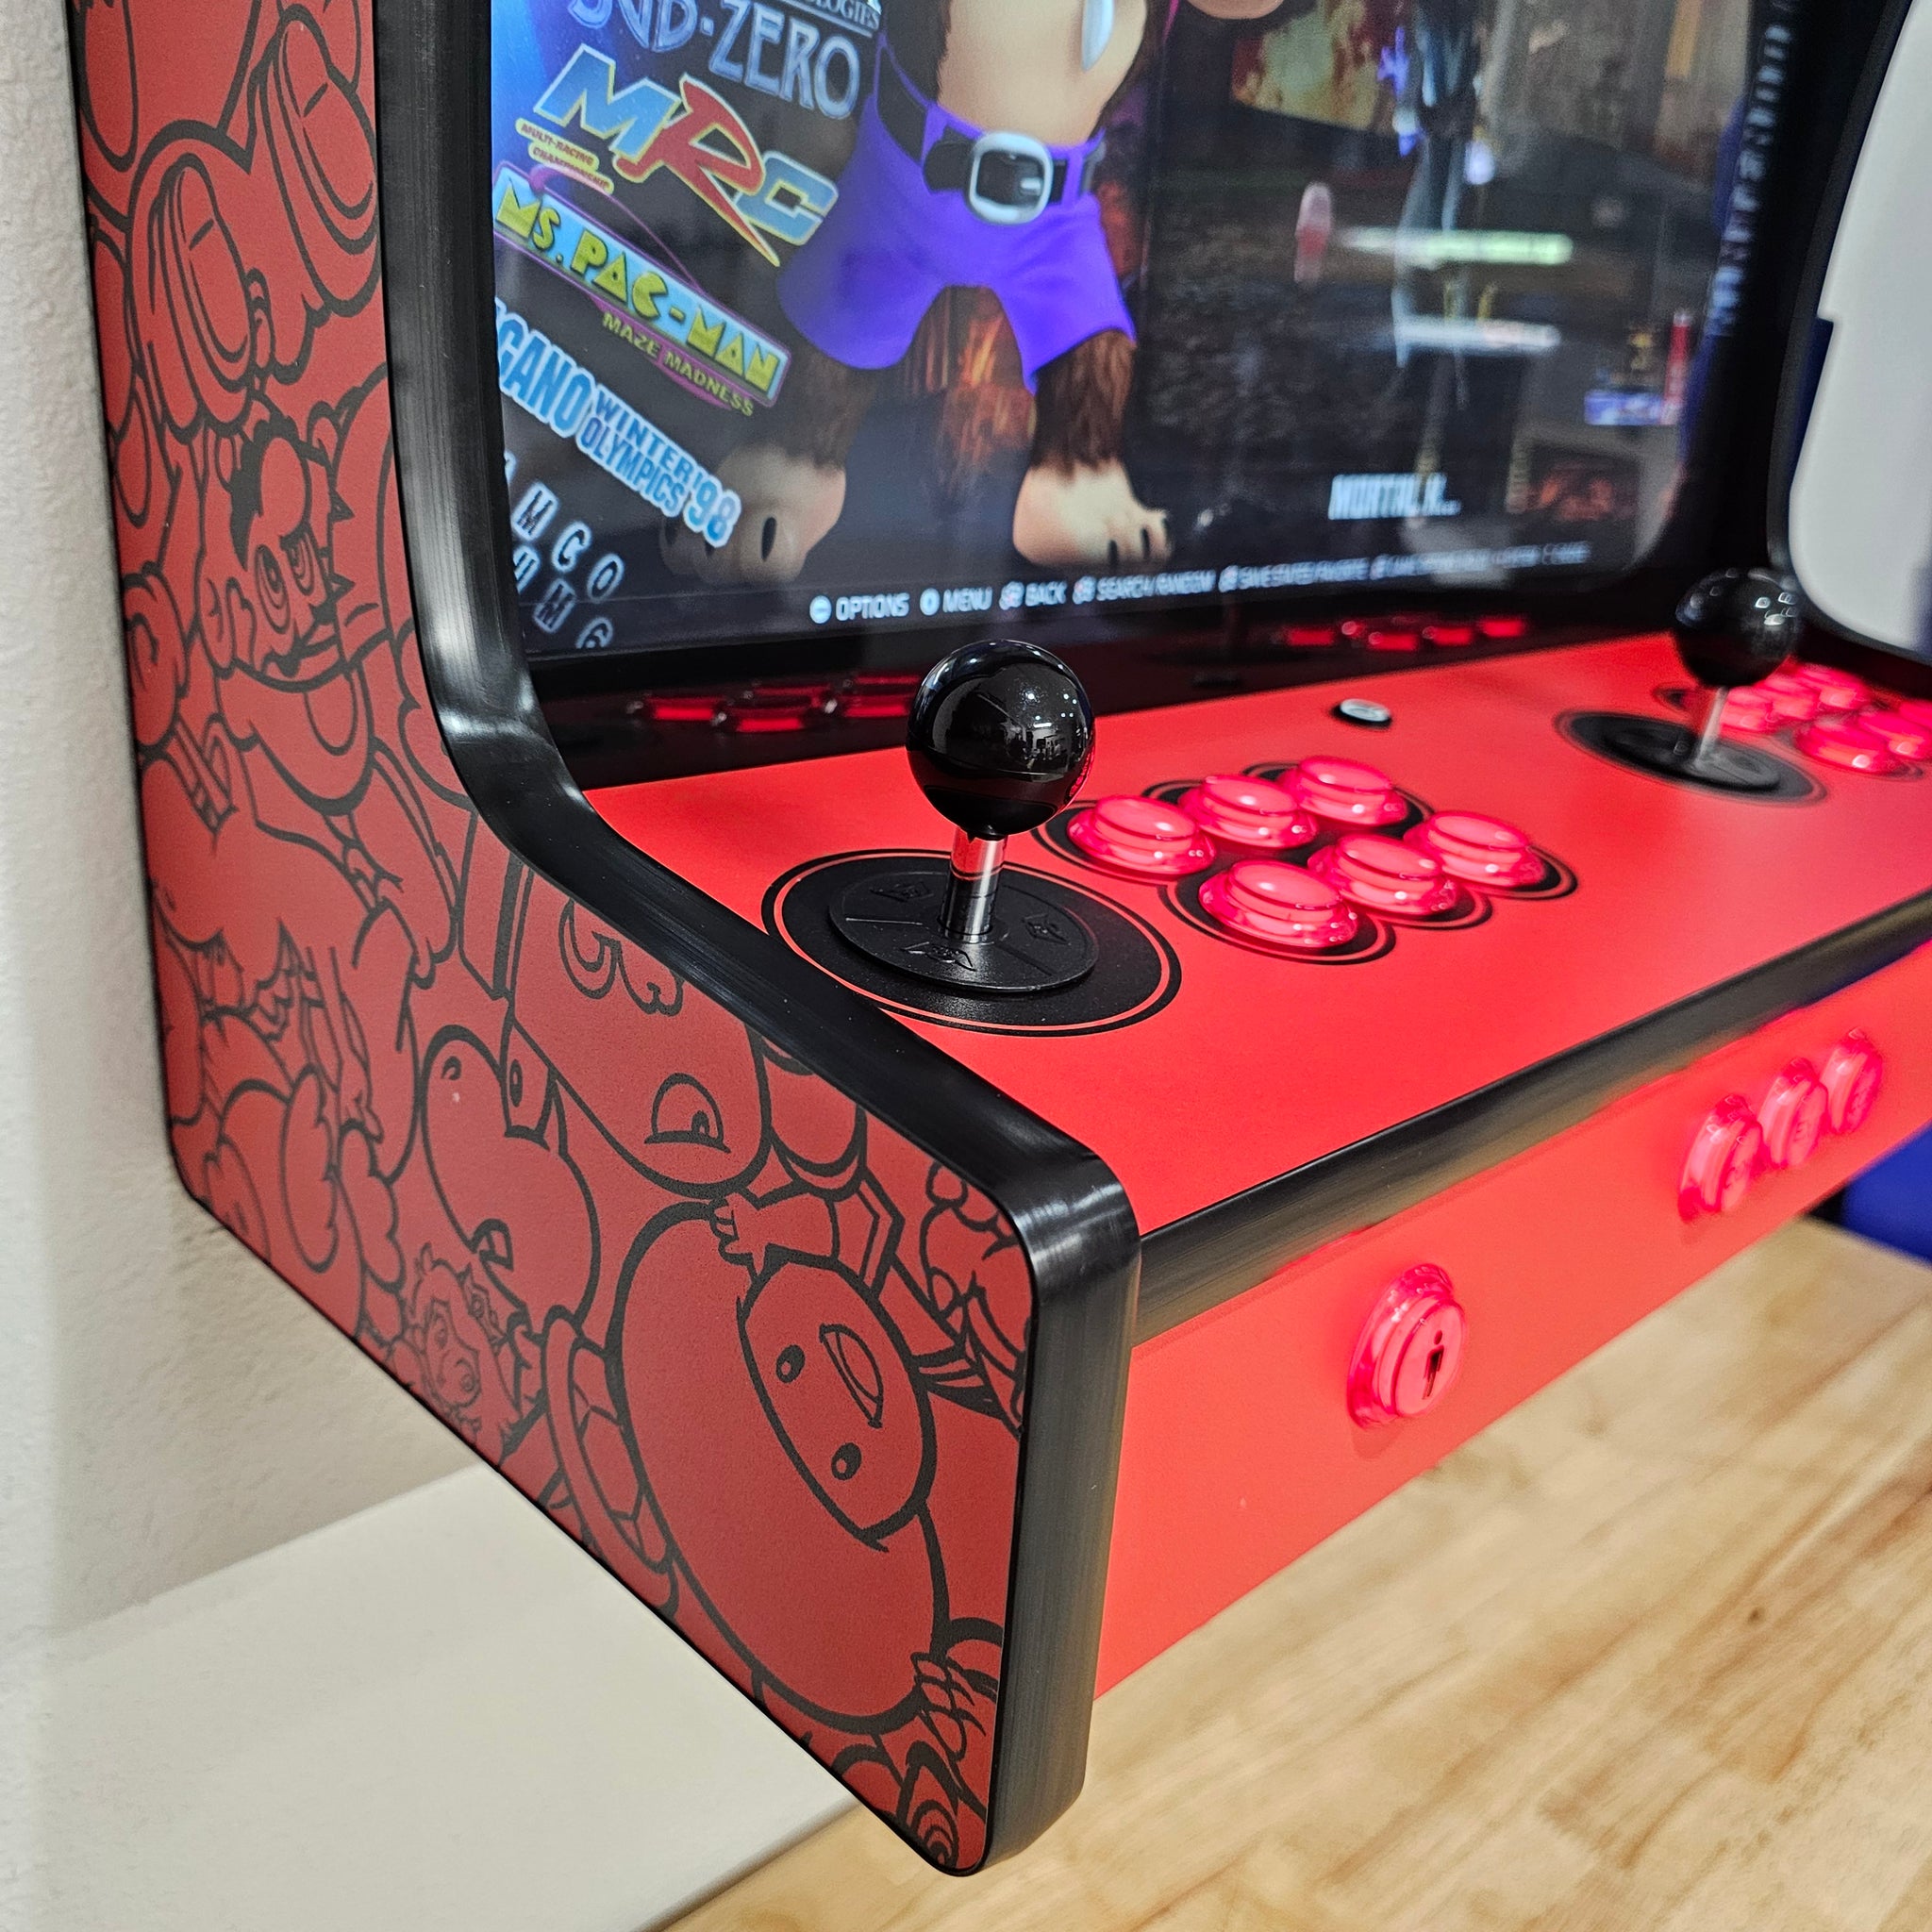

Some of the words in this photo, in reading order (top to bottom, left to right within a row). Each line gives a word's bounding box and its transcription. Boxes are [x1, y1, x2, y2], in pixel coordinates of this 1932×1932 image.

[533, 43, 840, 267] MRC
[495, 177, 563, 264] MS.
[570, 228, 781, 393] PAC-MAN
[603, 312, 658, 358] MAZE
[663, 350, 754, 417] MADNESS
[580, 416, 686, 512] OLYMPICS
[595, 387, 695, 484] WINTER
[684, 470, 739, 544] '98
[836, 592, 910, 622] OPTIONS
[942, 587, 992, 613] MENU
[1025, 581, 1068, 607] BACK
